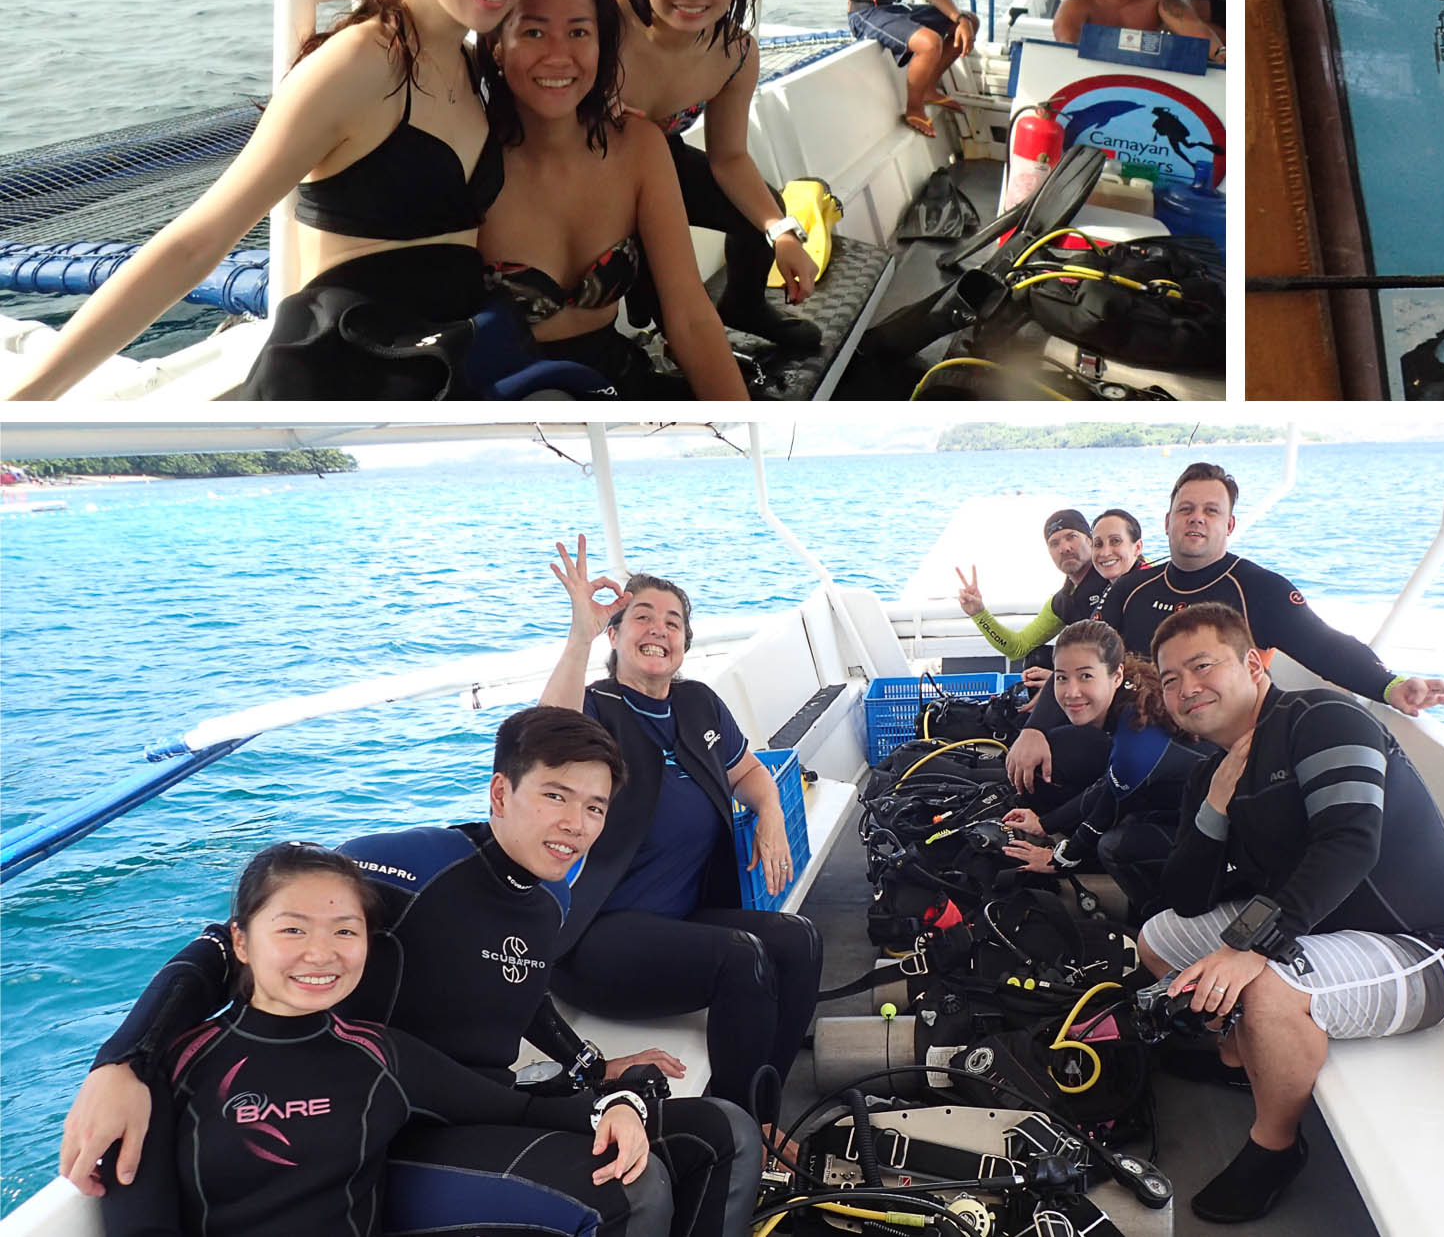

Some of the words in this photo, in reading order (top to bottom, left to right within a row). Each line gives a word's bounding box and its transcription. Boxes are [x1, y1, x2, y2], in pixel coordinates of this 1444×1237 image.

[1089, 130, 1169, 157] Camayan
[1117, 151, 1174, 173] Divrs
[979, 618, 1007, 648] VOLCOM
[481, 949, 546, 969] SCUBAPRO
[236, 1098, 331, 1123] BARE
